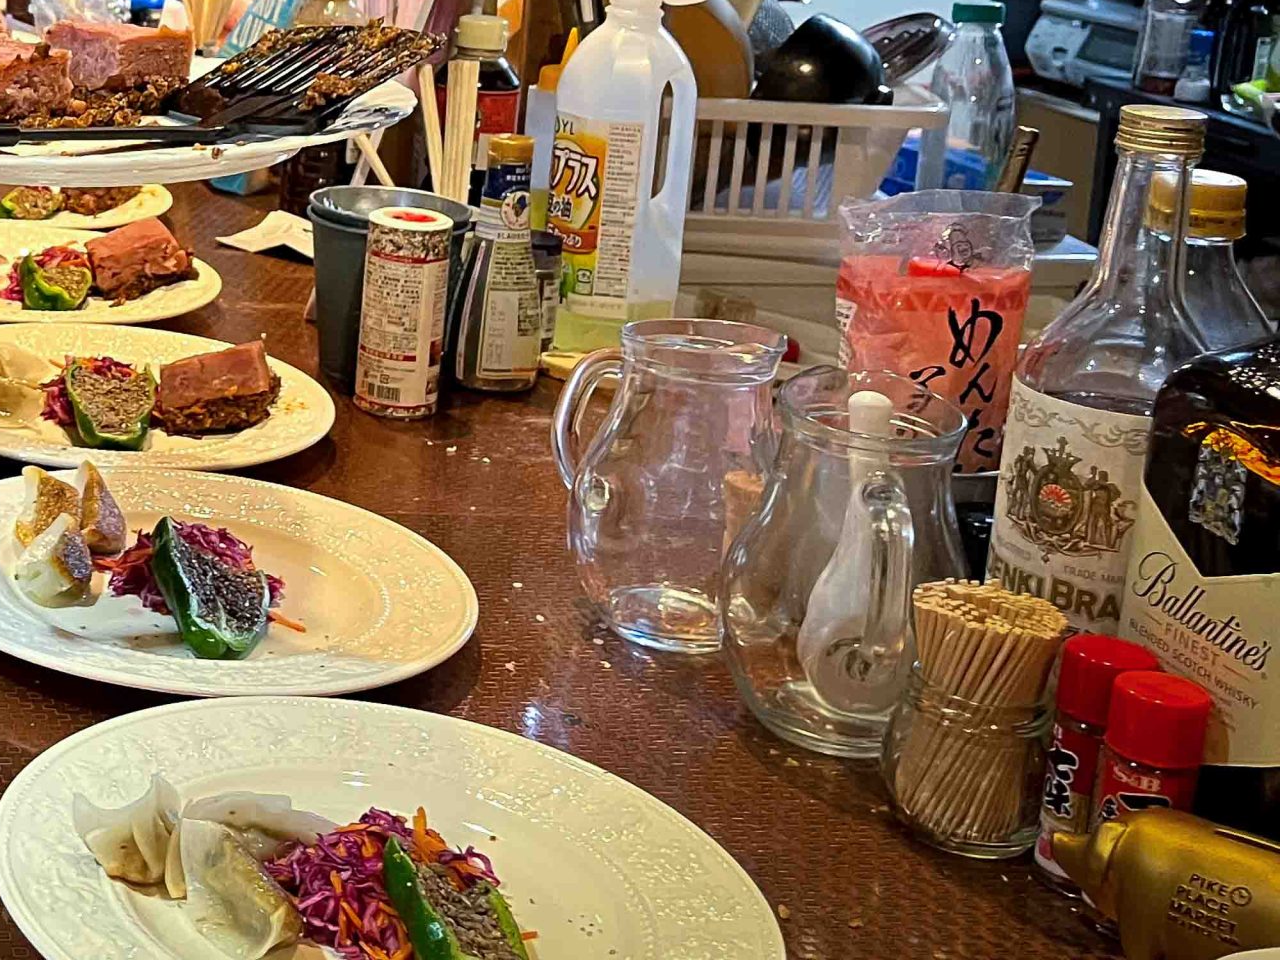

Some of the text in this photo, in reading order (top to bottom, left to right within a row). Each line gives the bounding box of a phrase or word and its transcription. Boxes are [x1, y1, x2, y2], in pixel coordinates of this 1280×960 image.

[947, 297, 1004, 472] めんた
[988, 550, 1043, 597] ENKI
[1051, 577, 1120, 621] BRA
[1063, 565, 1125, 583] TRADE MAR
[1132, 551, 1272, 671] Ballantine's
[1128, 617, 1170, 654] BLENDED
[1171, 648, 1212, 683] SCOTCH
[1214, 675, 1259, 710] WHISKY
[1164, 622, 1220, 667] FINEST
[1176, 884, 1231, 914] PLACE
[1189, 872, 1230, 897] PIKE
[1167, 898, 1238, 934] MARKET
